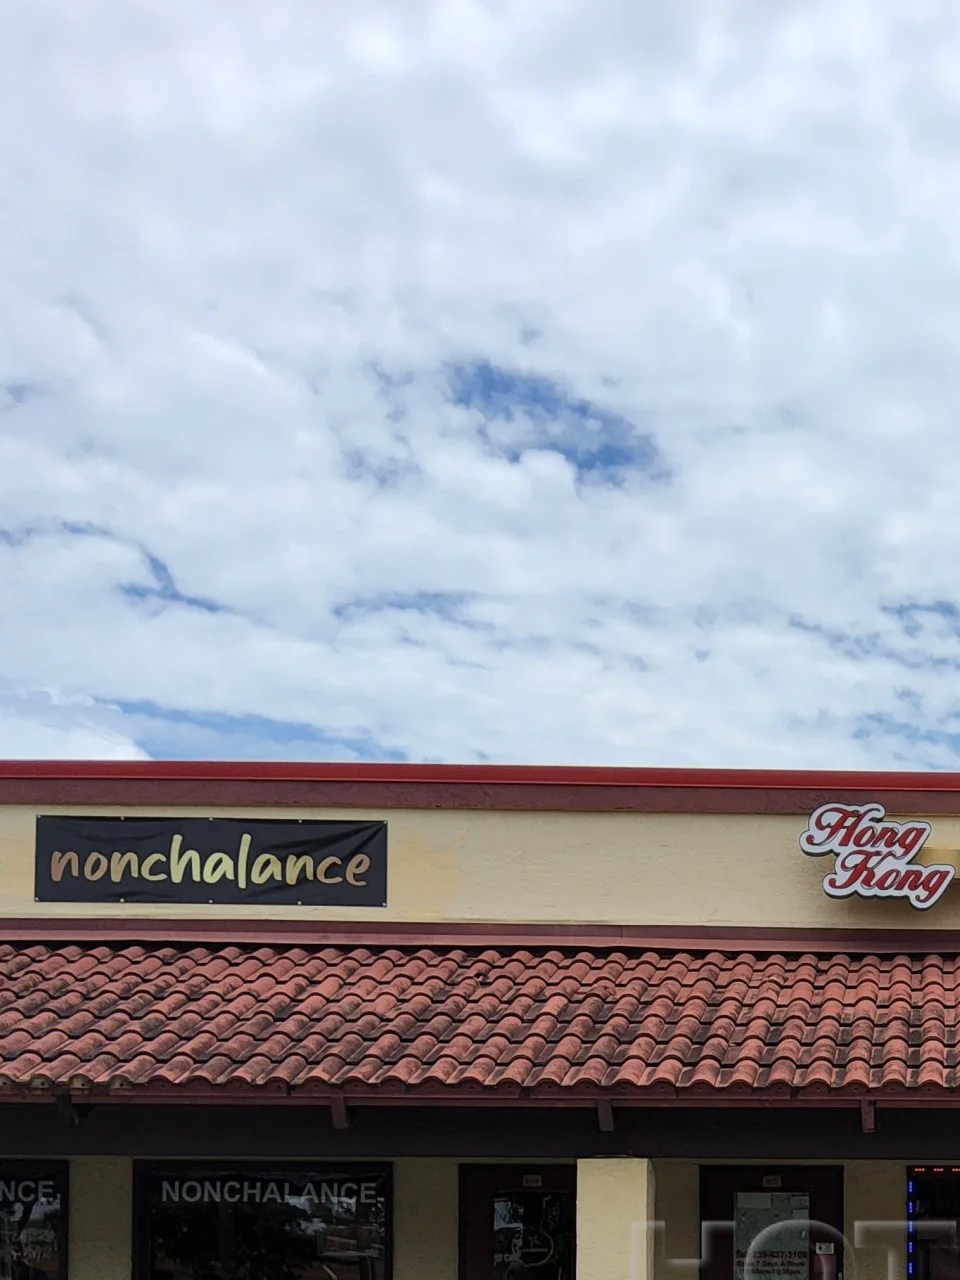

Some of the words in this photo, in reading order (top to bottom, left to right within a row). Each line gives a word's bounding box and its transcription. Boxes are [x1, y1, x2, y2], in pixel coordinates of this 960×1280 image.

[805, 806, 928, 861] Hong
[50, 833, 373, 890] nonchalance
[828, 849, 952, 904] Kong
[162, 1180, 378, 1204] NONCHALANCE
